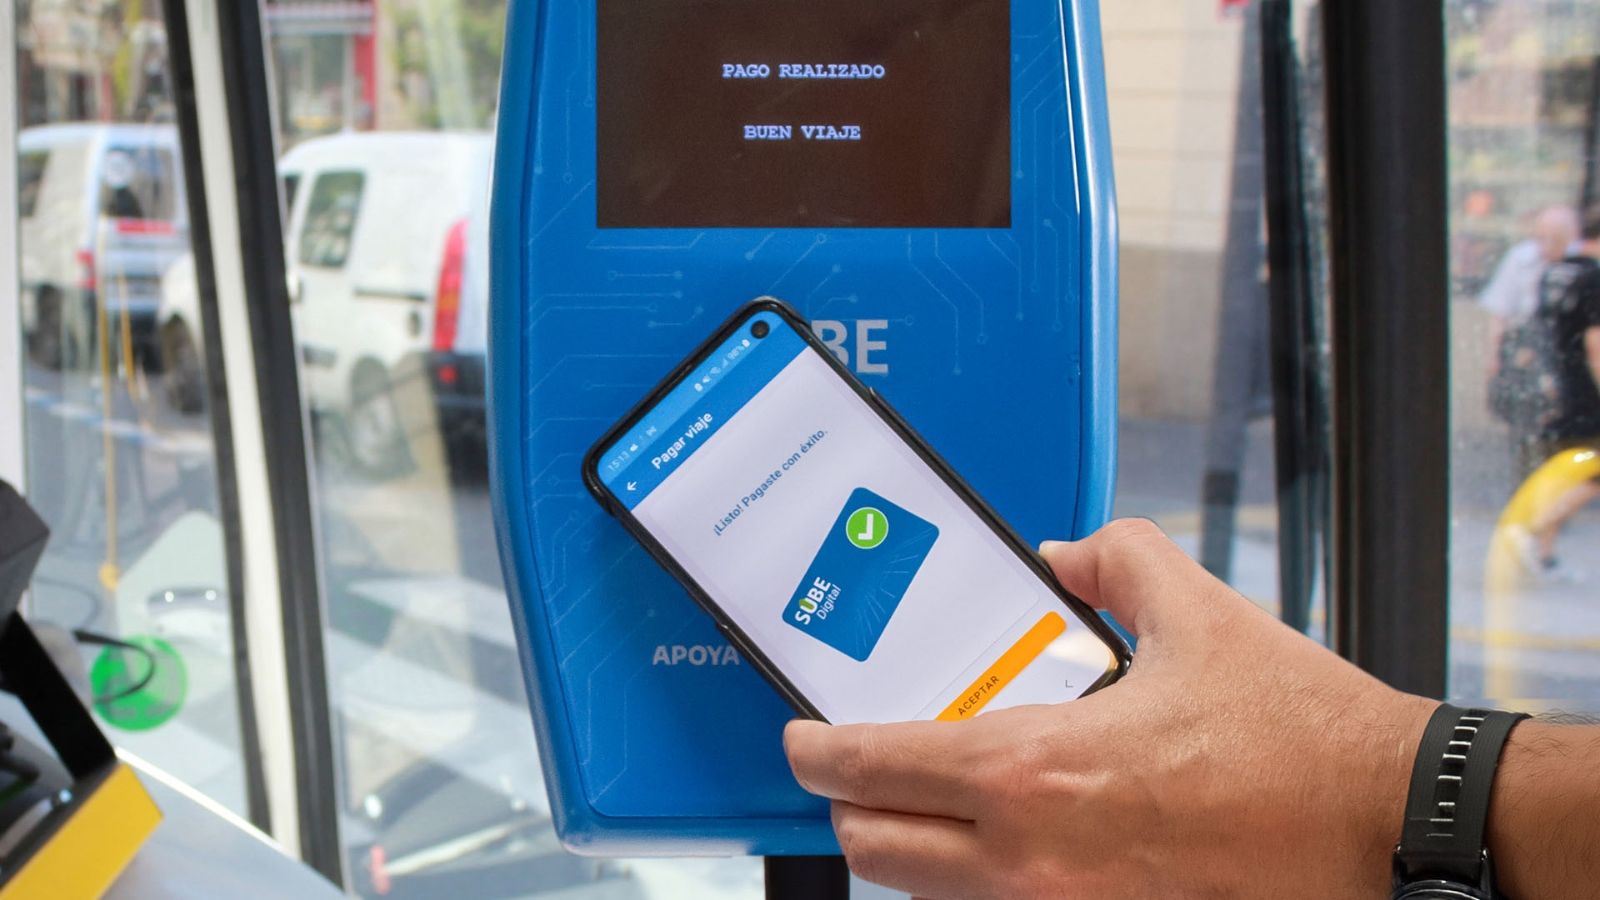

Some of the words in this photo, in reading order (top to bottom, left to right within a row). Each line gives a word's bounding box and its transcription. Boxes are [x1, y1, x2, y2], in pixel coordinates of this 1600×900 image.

[722, 63, 770, 78] PAGO
[779, 63, 885, 78] REALIZADO
[744, 124, 792, 139] BUEN
[801, 124, 861, 139] VIAJE
[811, 319, 888, 373] BE
[651, 437, 686, 469] Pagar
[685, 413, 713, 439] viaje
[713, 504, 744, 536] ¡Listo!
[741, 470, 782, 507] Pagaste
[782, 452, 801, 471] con
[800, 430, 828, 453] éxito.
[795, 576, 831, 625] SUBE
[816, 583, 841, 620] Digital
[652, 644, 740, 666] APOYA
[957, 675, 999, 716] ACEPTAR
